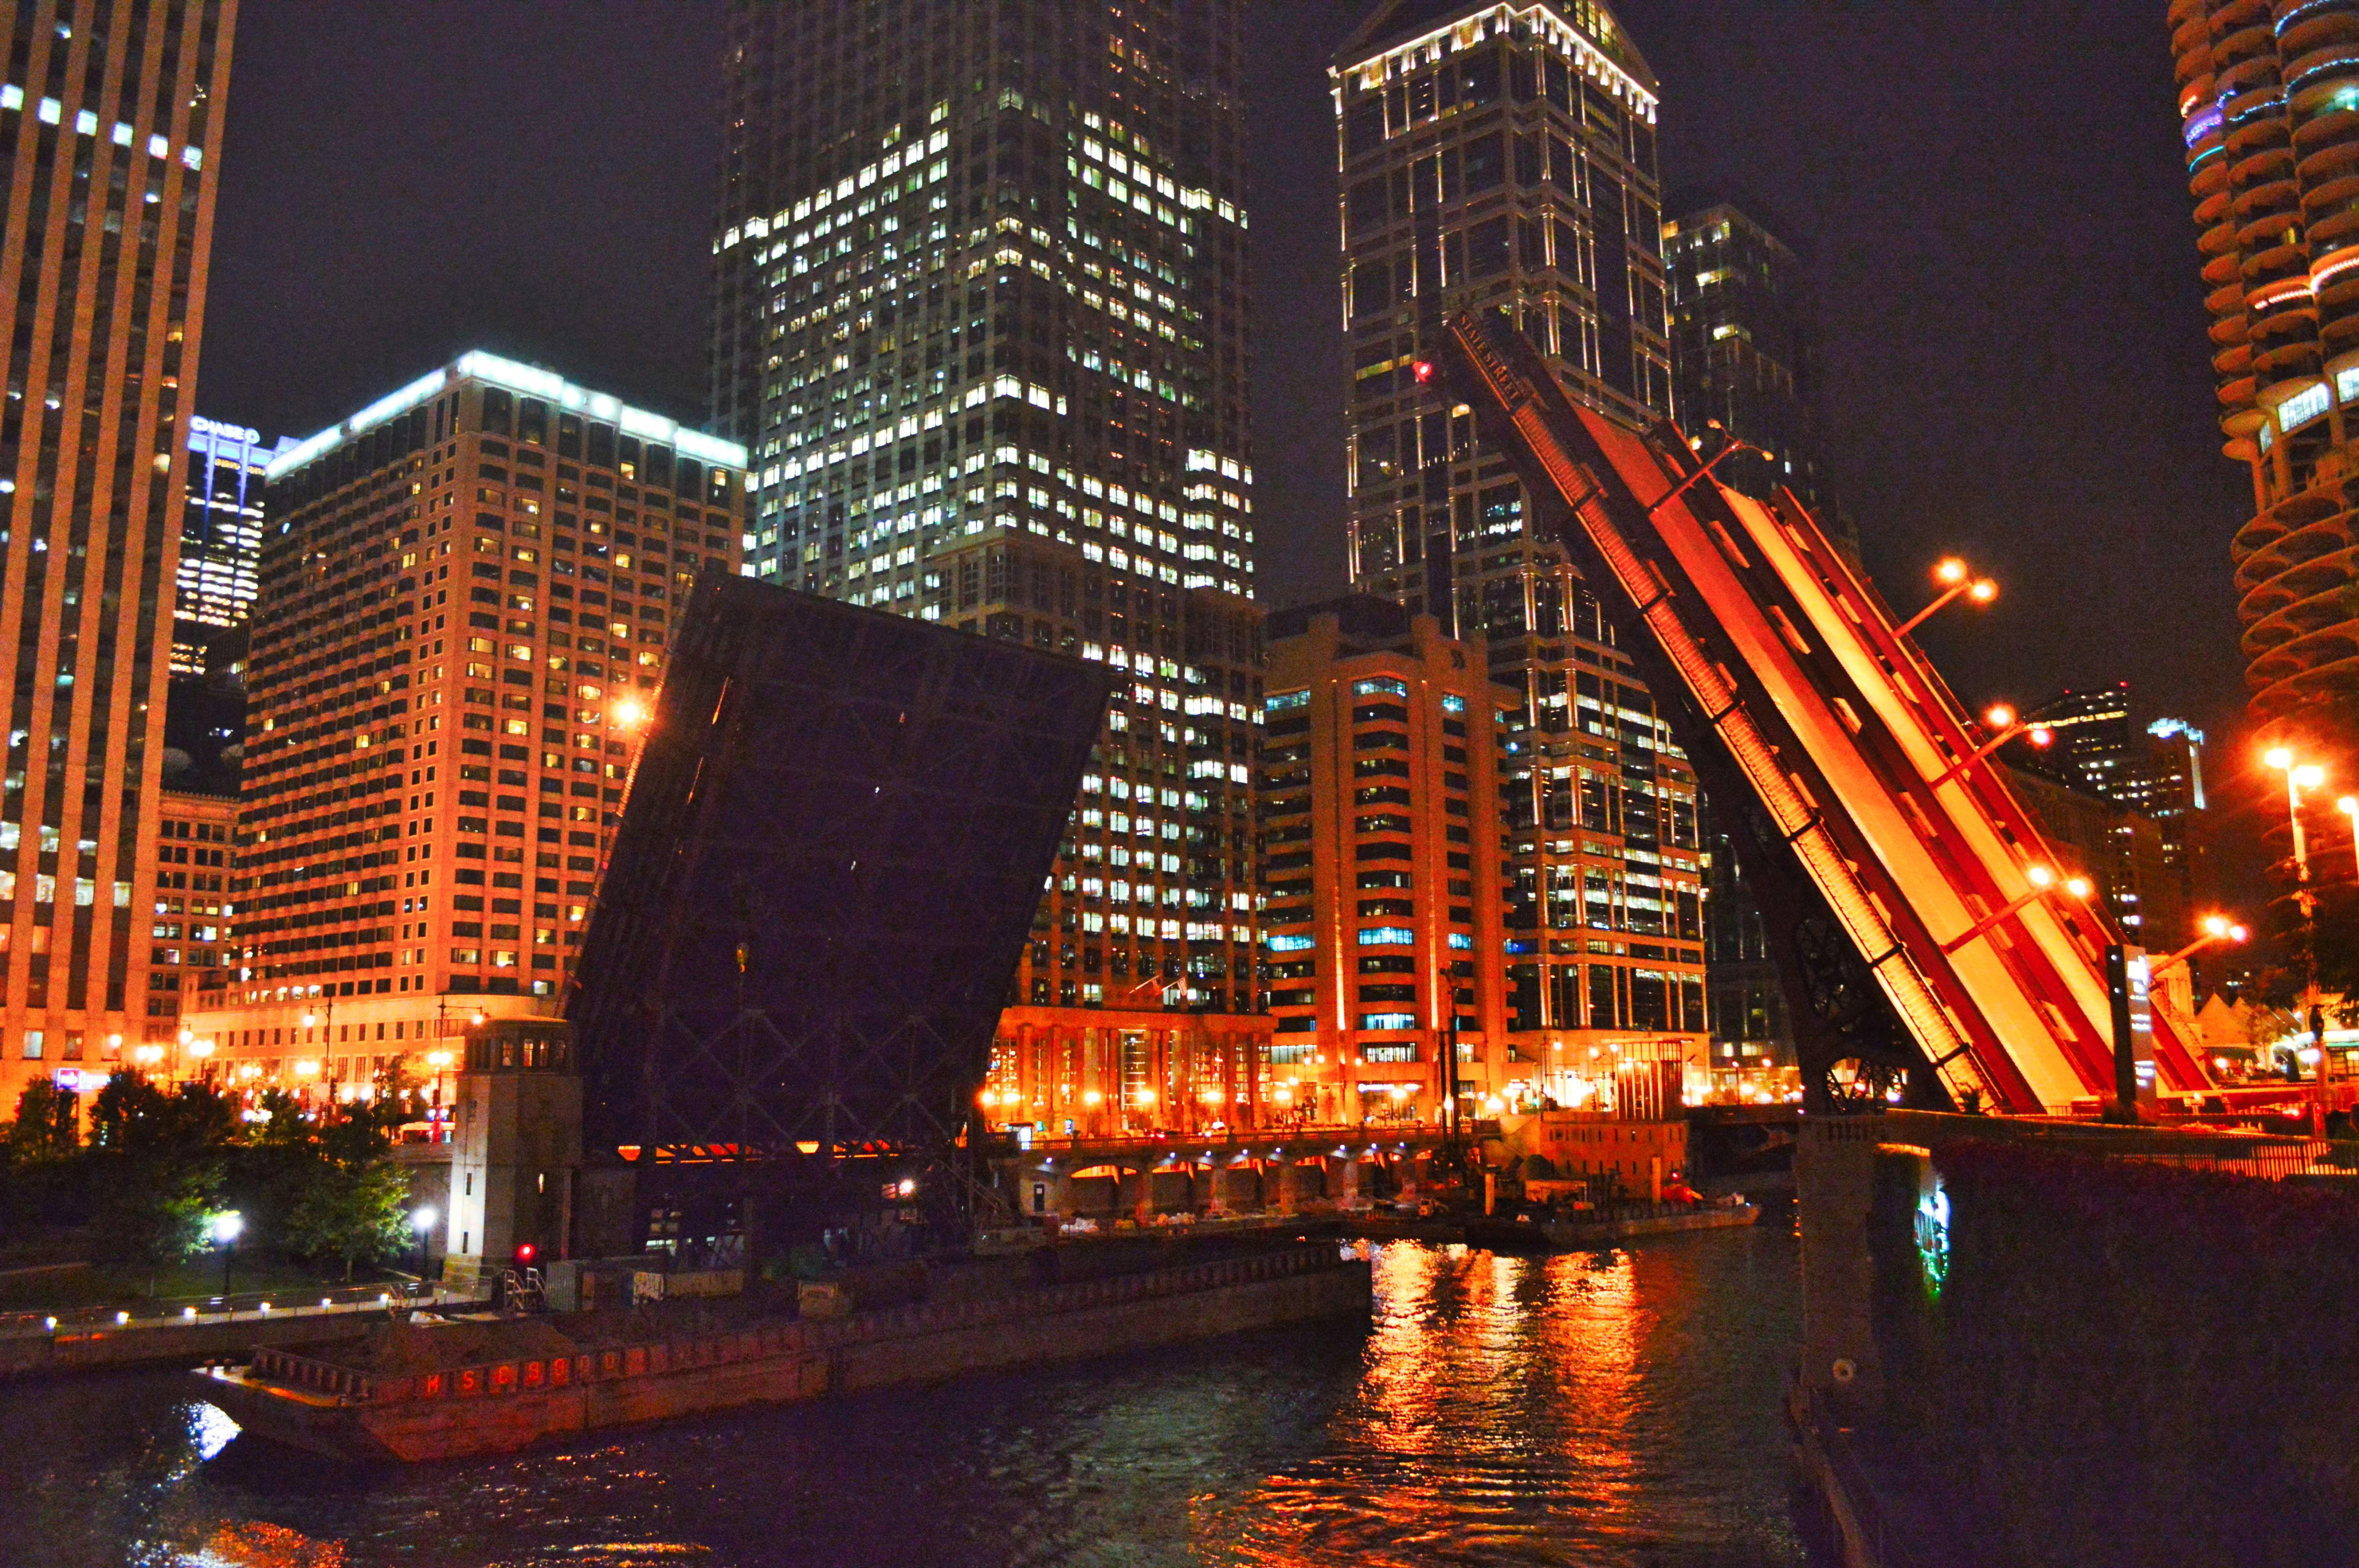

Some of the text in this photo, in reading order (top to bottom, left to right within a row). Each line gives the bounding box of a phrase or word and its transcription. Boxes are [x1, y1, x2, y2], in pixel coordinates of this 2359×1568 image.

[1461, 315, 1519, 399] STATE STREET
[191, 416, 245, 440] CHASE
